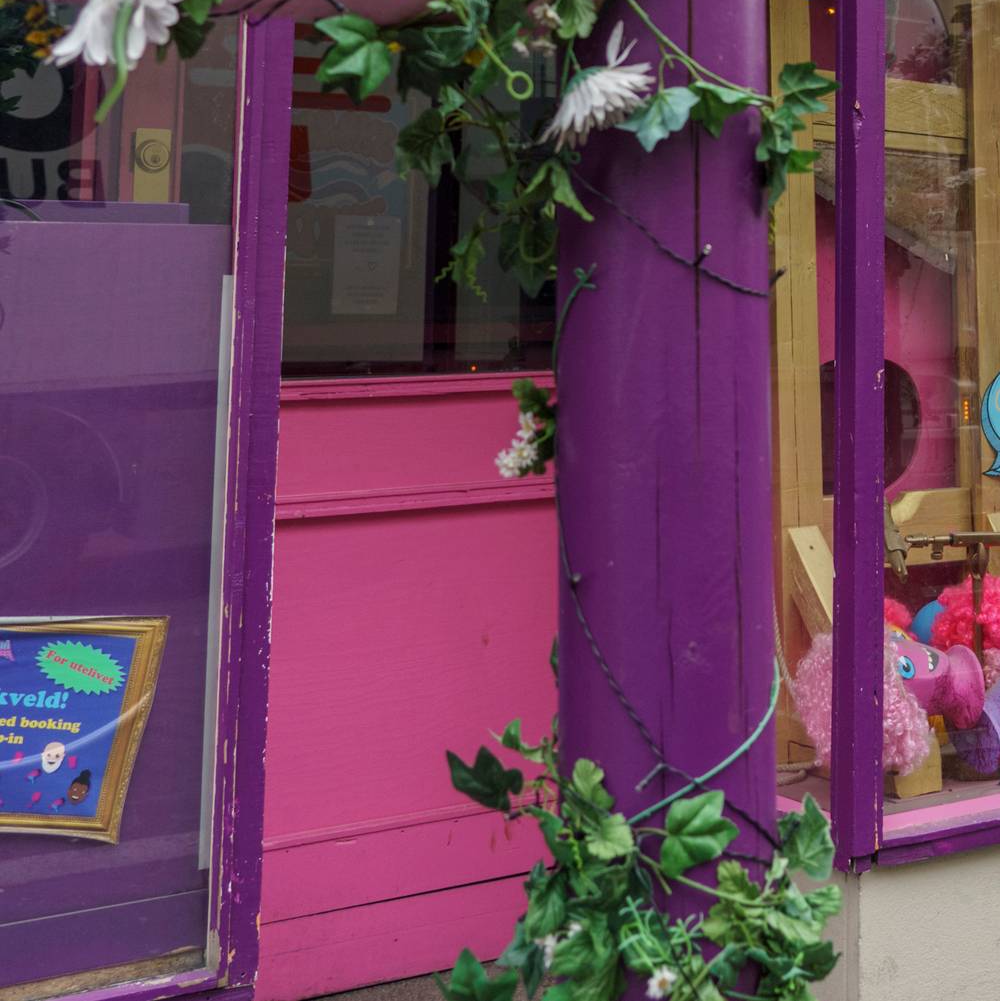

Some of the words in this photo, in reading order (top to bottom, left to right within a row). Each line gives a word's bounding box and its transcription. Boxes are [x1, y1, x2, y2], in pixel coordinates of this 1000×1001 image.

[45, 650, 69, 665] For
[69, 661, 115, 685] utelivet
[20, 716, 82, 734] booking
